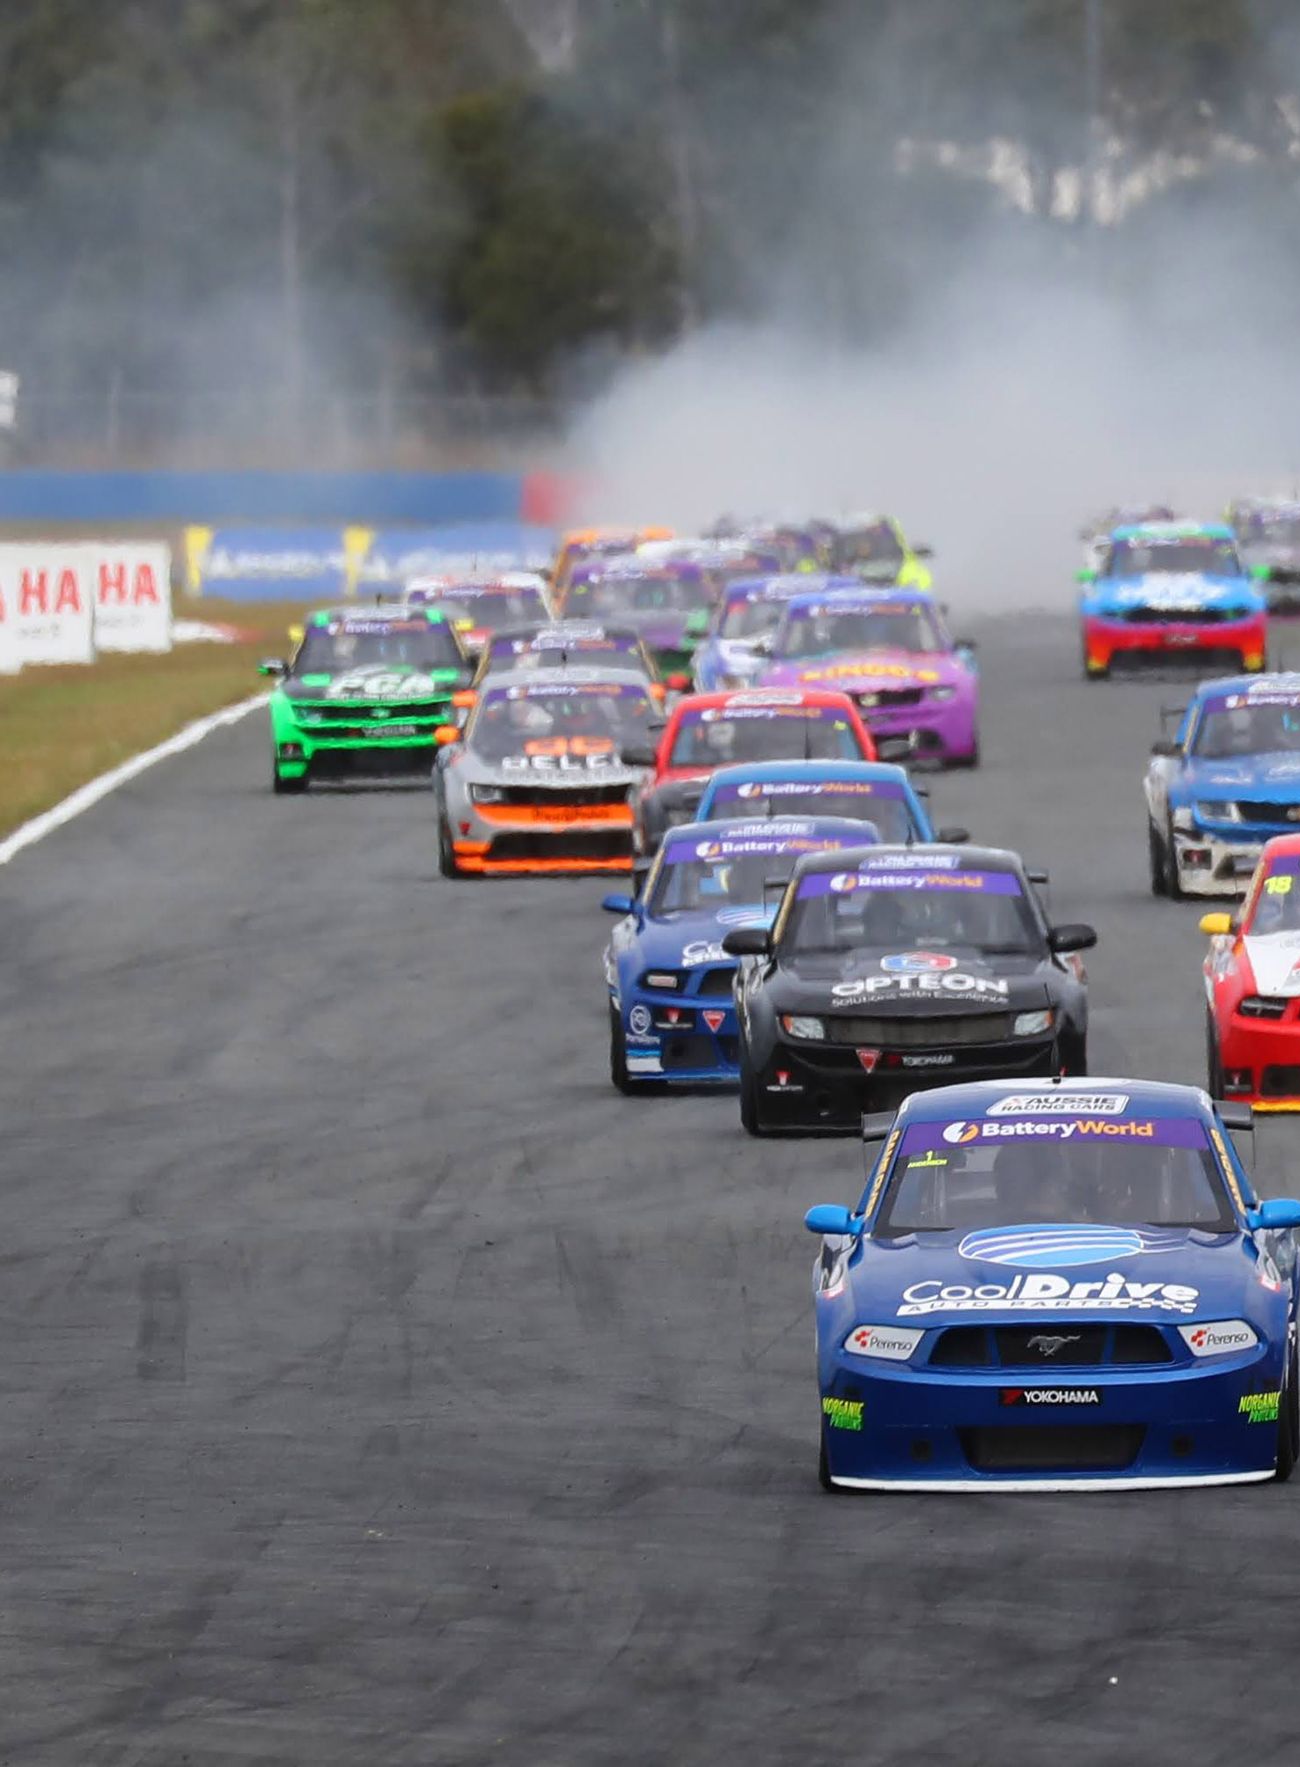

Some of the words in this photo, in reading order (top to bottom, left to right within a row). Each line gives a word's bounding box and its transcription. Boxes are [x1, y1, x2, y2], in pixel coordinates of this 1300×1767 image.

[832, 972, 1009, 997] OPTEON
[1026, 1096, 1119, 1105] AUSSIE
[982, 1120, 1154, 1138] BatteryWorld
[902, 1272, 1200, 1303] CoolDrive
[870, 1336, 913, 1351] Perenso
[1207, 1332, 1249, 1346] Perenso
[1024, 1390, 1099, 1403] YOKOHAMA
